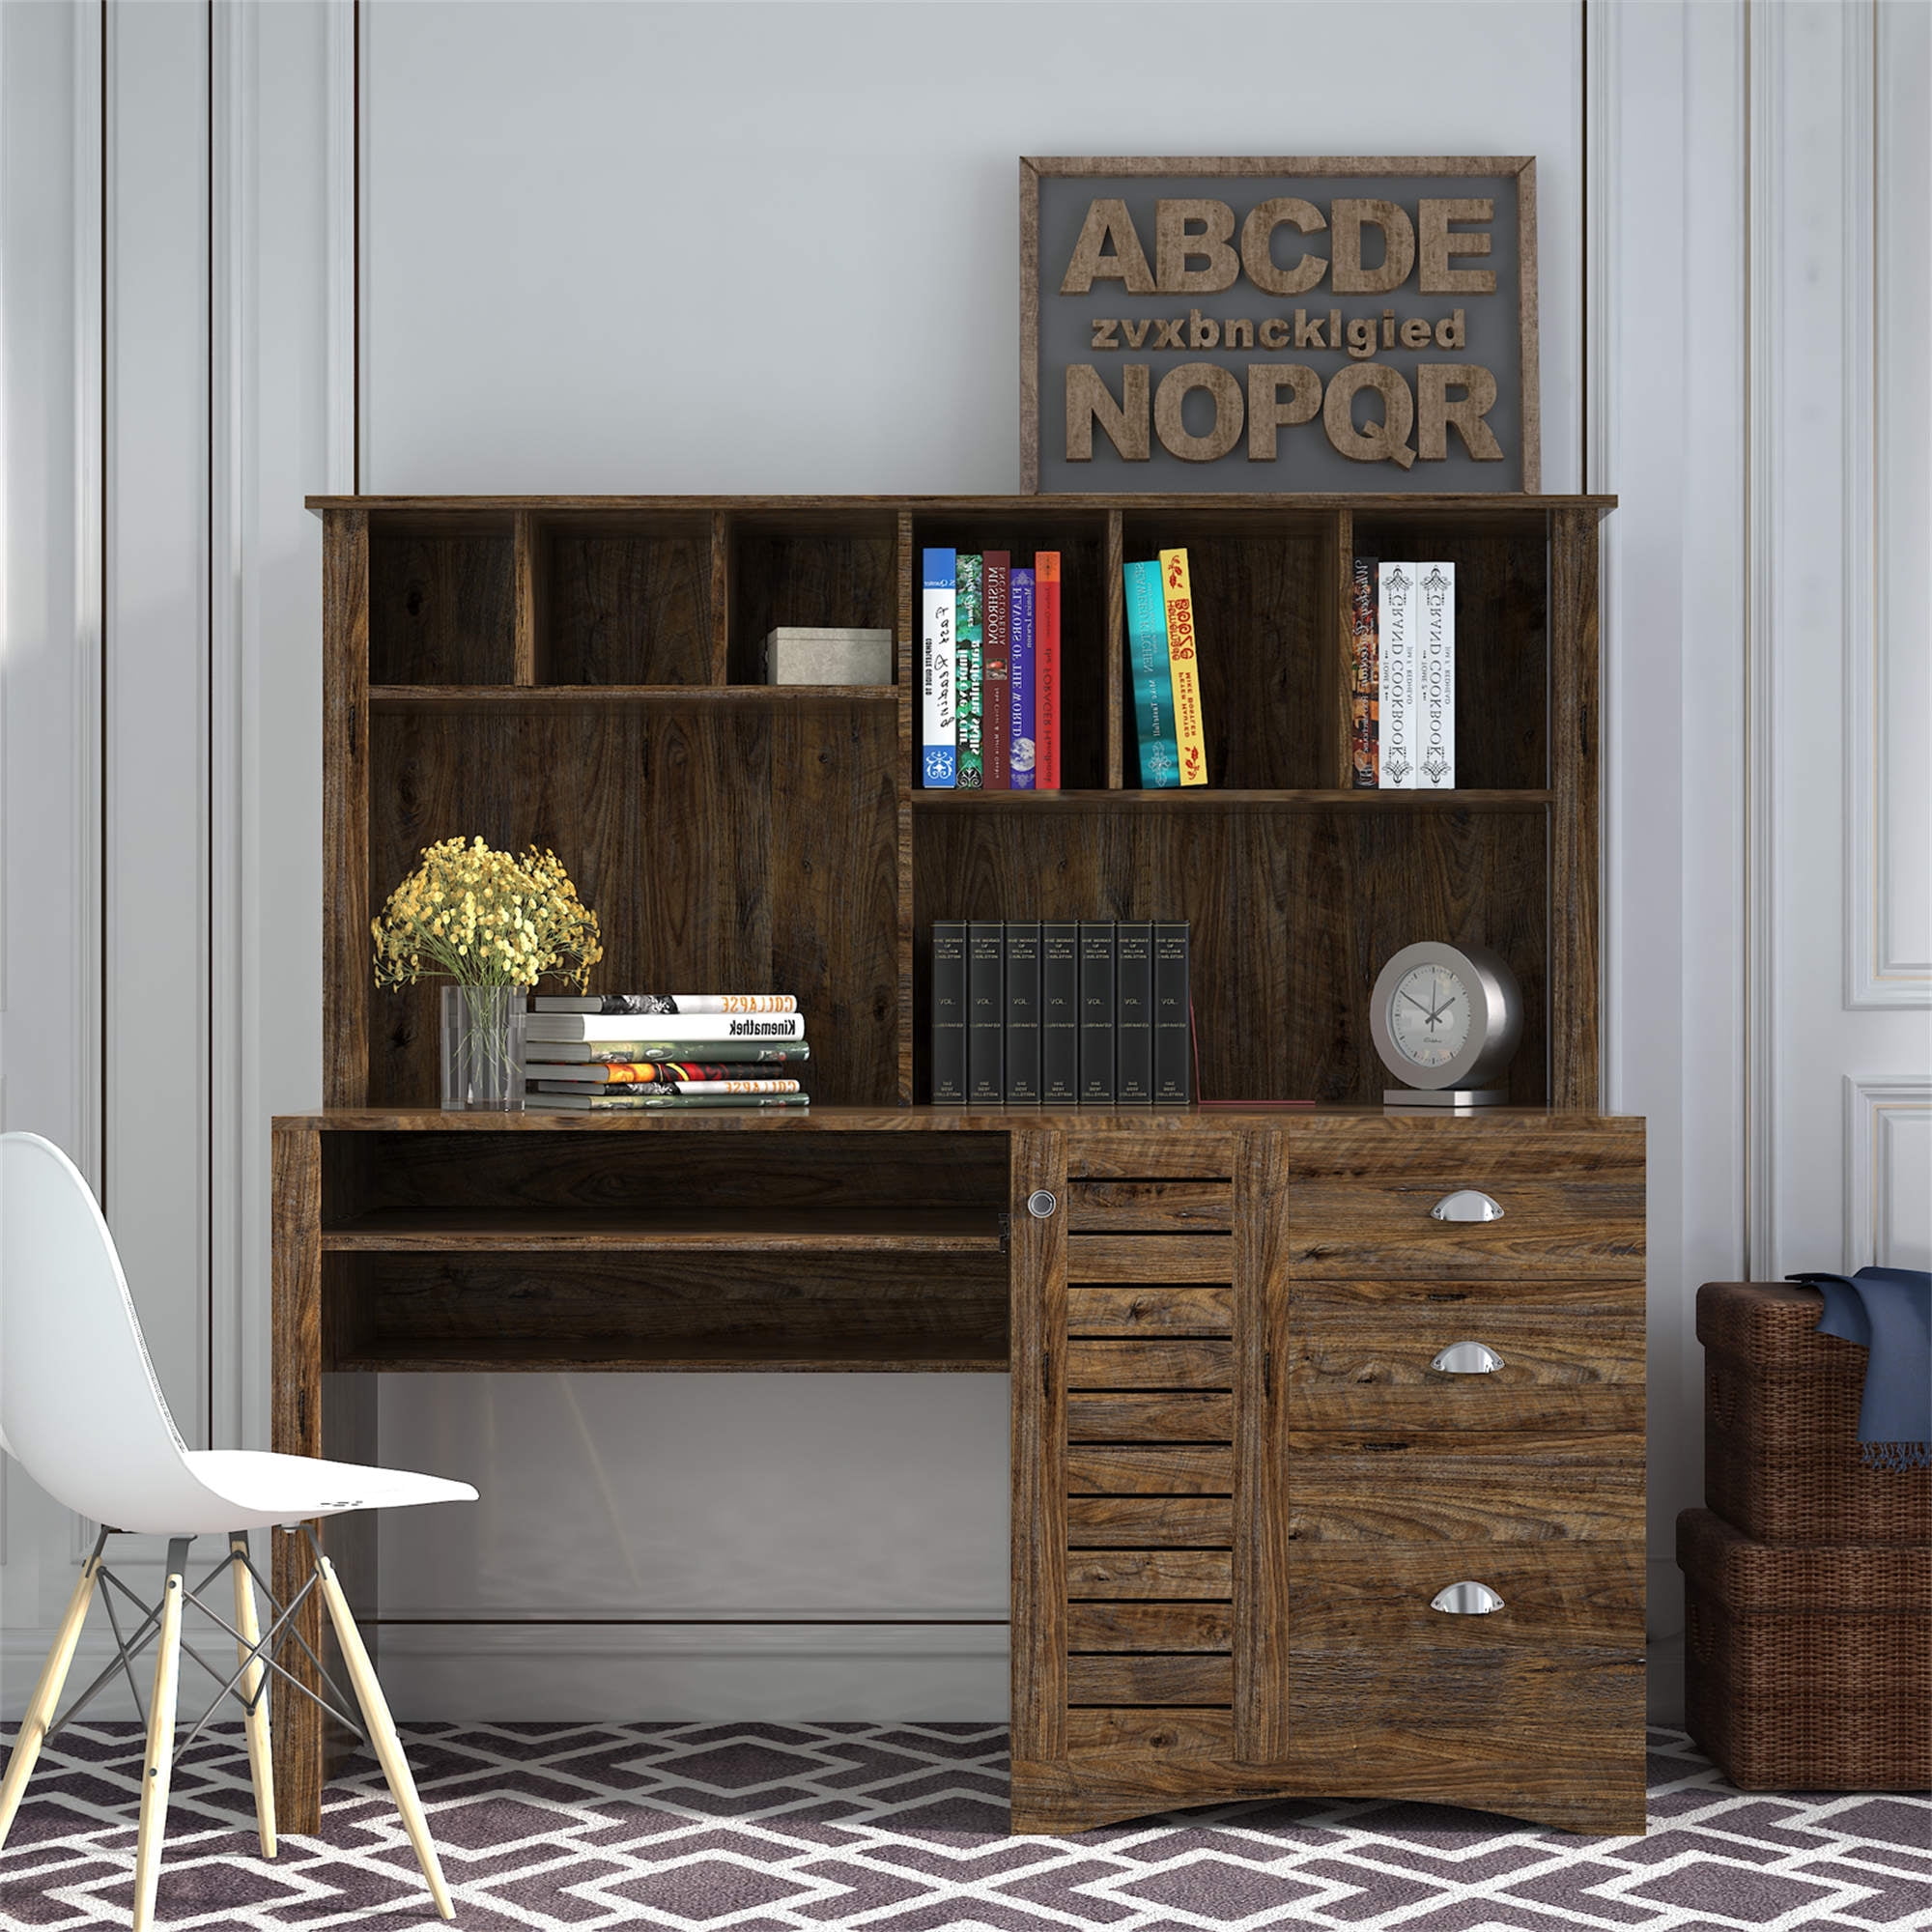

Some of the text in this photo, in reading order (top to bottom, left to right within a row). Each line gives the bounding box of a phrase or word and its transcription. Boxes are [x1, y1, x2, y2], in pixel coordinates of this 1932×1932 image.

[1061, 197, 1496, 296] ABCDE
[1092, 308, 1465, 358] zvxbncklgied
[1065, 362, 1504, 470] NOPQR
